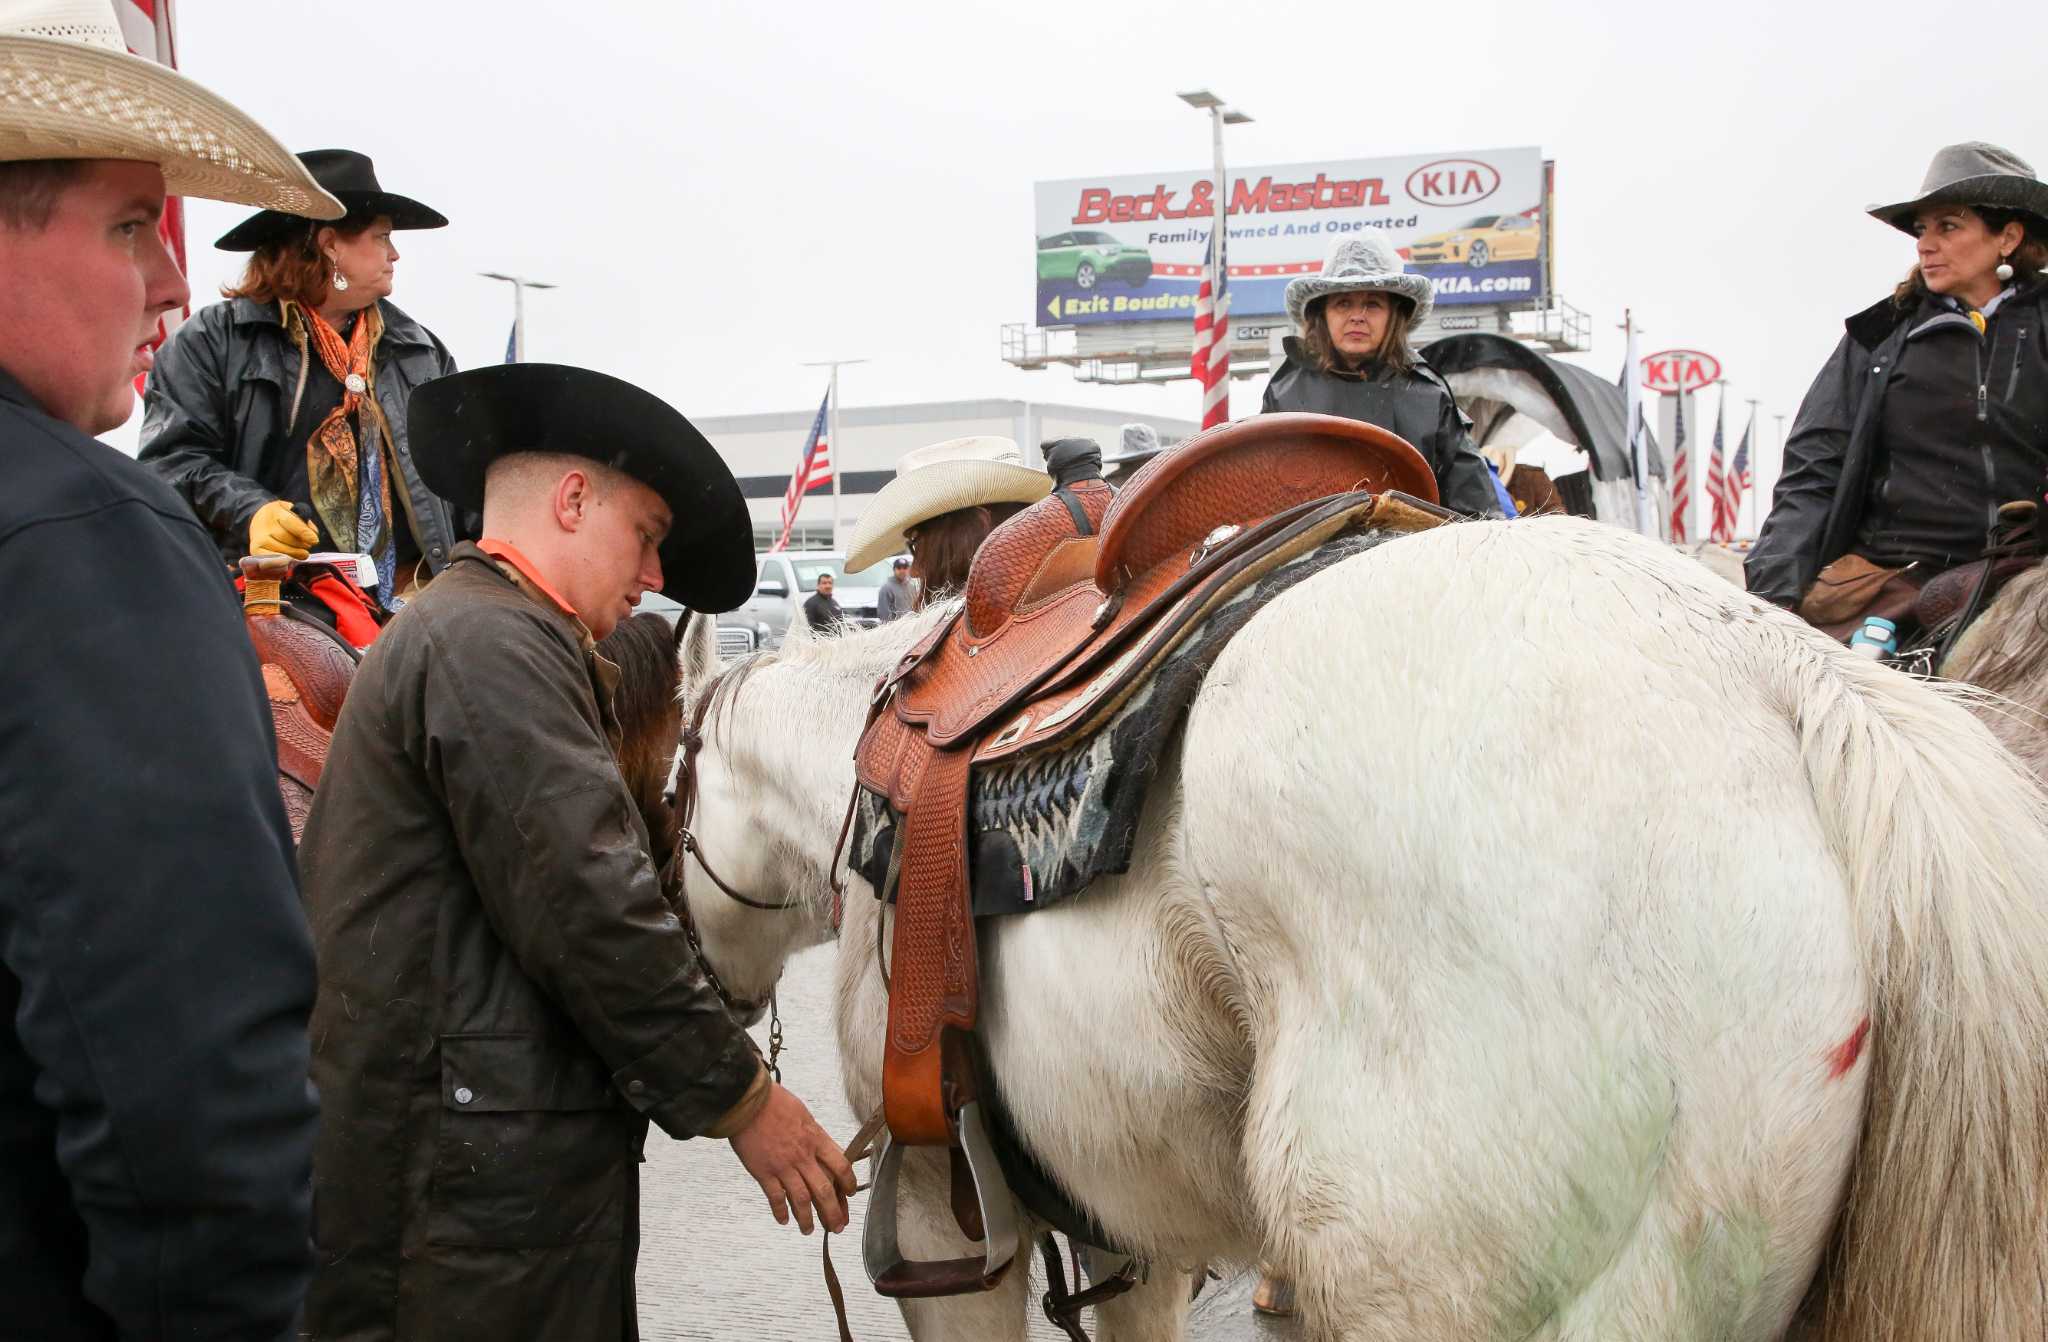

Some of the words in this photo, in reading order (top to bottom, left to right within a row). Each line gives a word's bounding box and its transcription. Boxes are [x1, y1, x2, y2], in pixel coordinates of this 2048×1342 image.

[1423, 170, 1484, 197] KIA
[1072, 184, 1188, 225] Beck
[1186, 180, 1215, 218] &
[1225, 173, 1390, 216] Masten
[1148, 229, 1209, 244] Family
[1229, 224, 1280, 239] wned
[1283, 222, 1321, 236] And
[1064, 298, 1110, 315] Exit
[1113, 292, 1232, 312] Boudre
[1647, 359, 1707, 385] KIA
